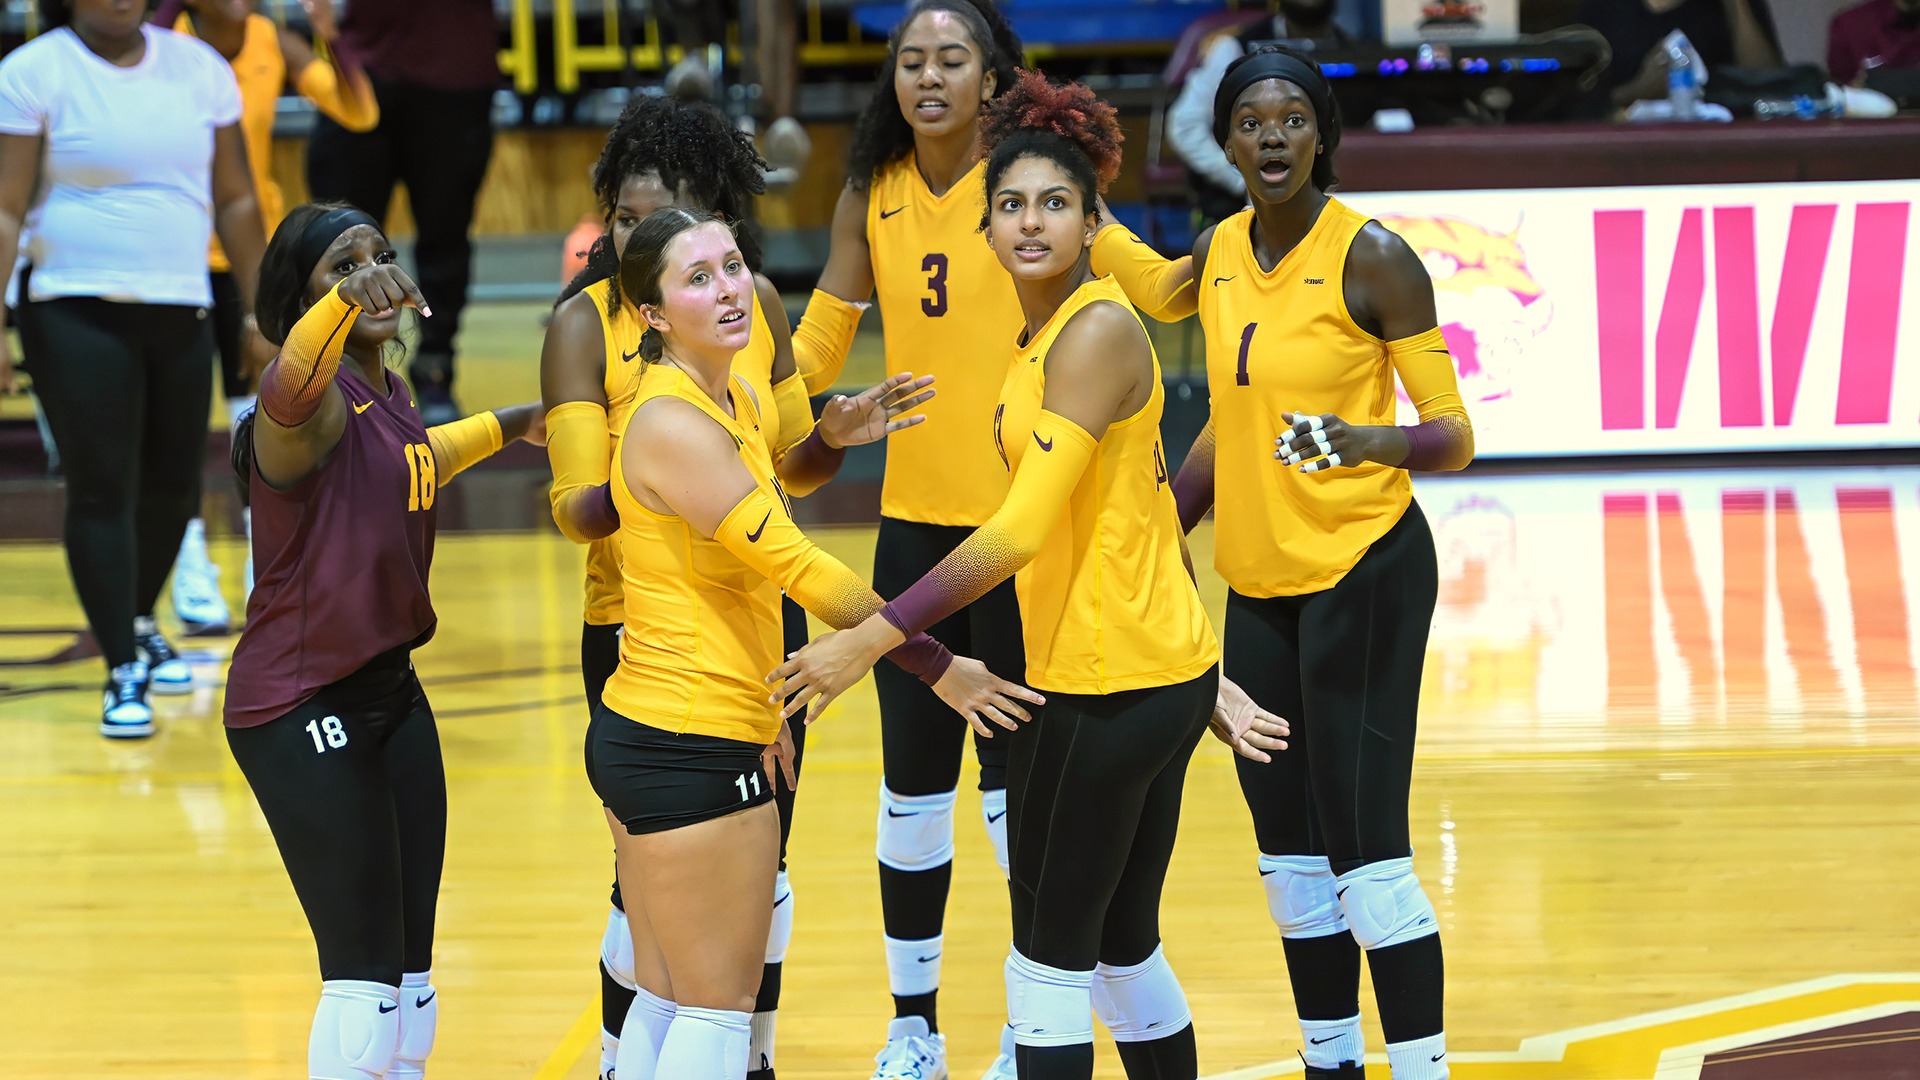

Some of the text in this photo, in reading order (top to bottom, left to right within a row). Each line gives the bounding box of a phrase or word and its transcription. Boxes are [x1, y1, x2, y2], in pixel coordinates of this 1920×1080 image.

[921, 253, 948, 317] 3
[1236, 322, 1258, 386] 1
[404, 443, 436, 511] 18
[305, 715, 348, 754] 18
[735, 771, 761, 802] 11
